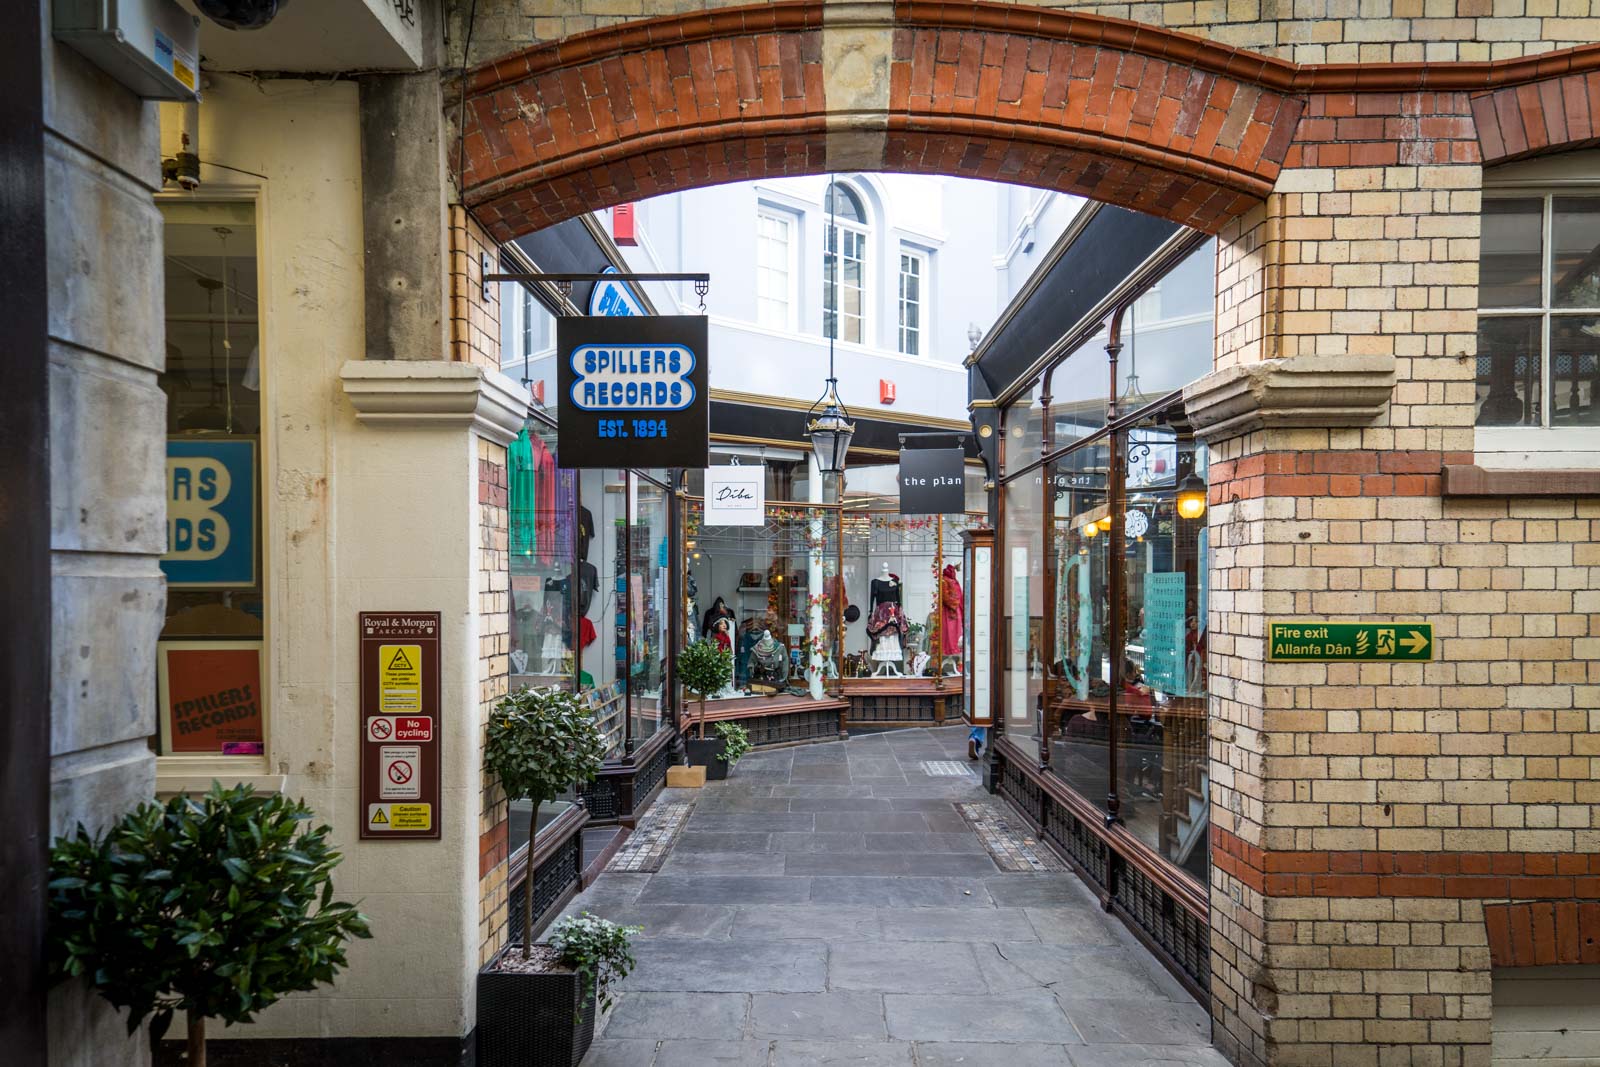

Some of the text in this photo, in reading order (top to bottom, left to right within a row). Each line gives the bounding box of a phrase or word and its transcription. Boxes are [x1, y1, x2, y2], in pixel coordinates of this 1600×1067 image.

[584, 350, 681, 374] SPILLERS
[584, 381, 682, 405] RECORDS
[598, 419, 668, 438] EST. 1894
[904, 475, 962, 489] the plan
[715, 486, 754, 502] Diba
[364, 618, 436, 629] Royal & Morgan
[1275, 627, 1329, 638] Fire exit
[1275, 643, 1351, 655] Allanfa Dân
[174, 683, 252, 720] SPILLERS
[177, 702, 257, 736] RECORDS
[407, 720, 420, 728] No
[397, 729, 429, 738] cycling
